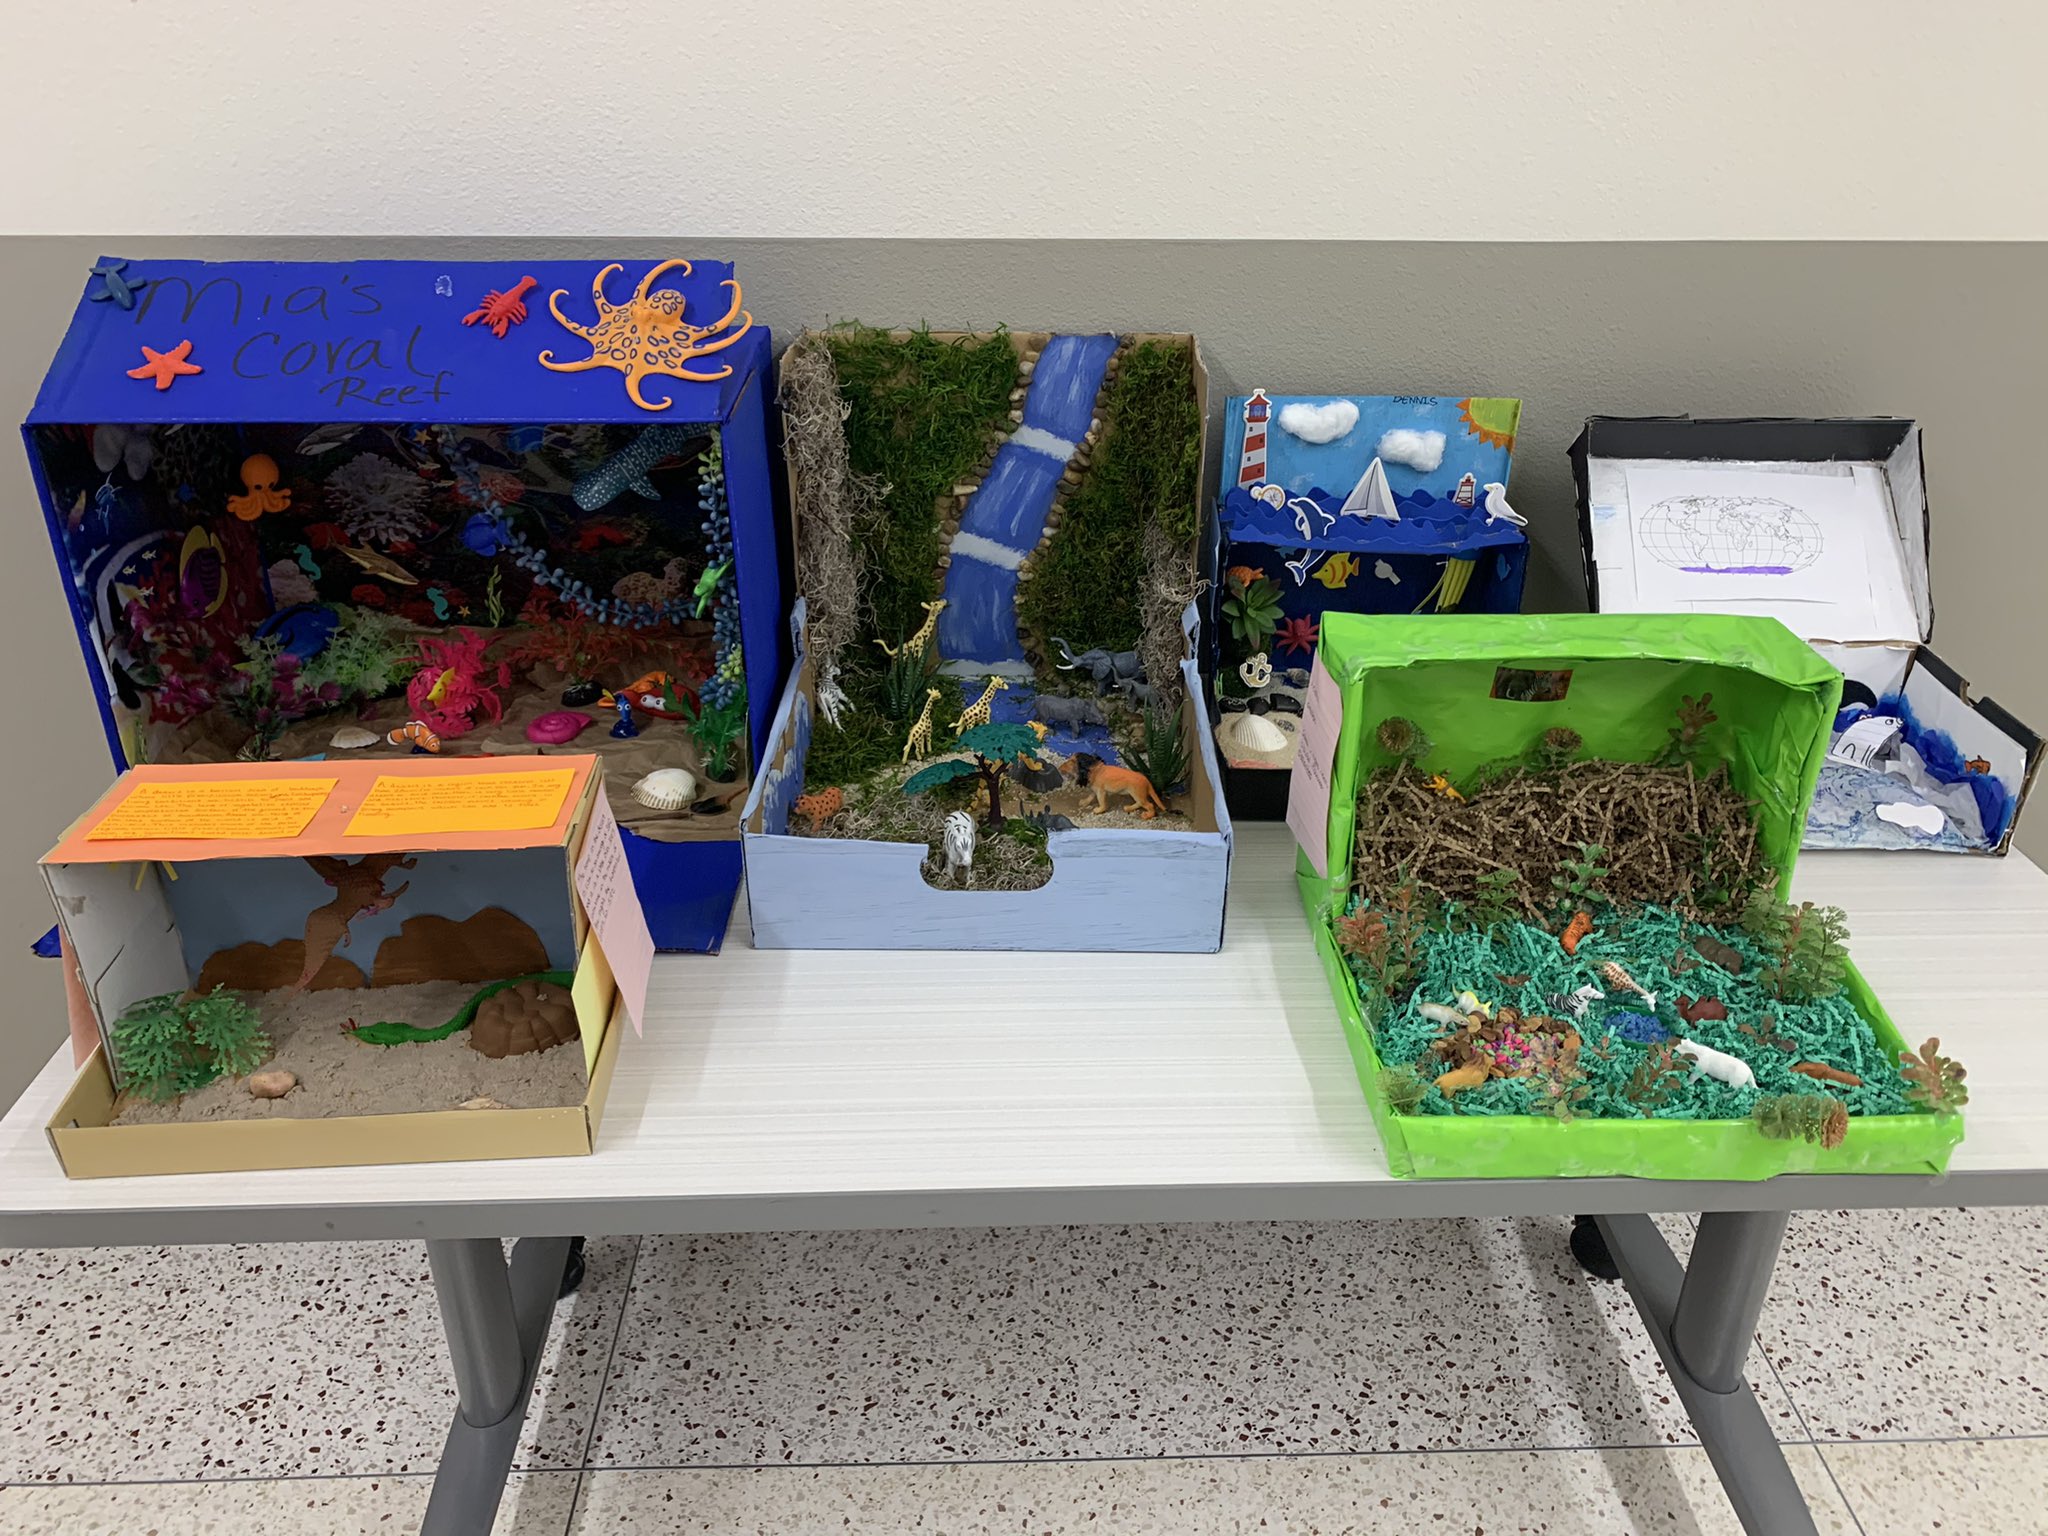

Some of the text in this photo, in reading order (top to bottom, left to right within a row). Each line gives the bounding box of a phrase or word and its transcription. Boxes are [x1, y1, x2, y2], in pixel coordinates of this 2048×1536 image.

[135, 275, 382, 325] Mia's
[232, 325, 435, 378] Coral
[318, 370, 454, 408] Reef
[1392, 396, 1438, 406] DENNIS
